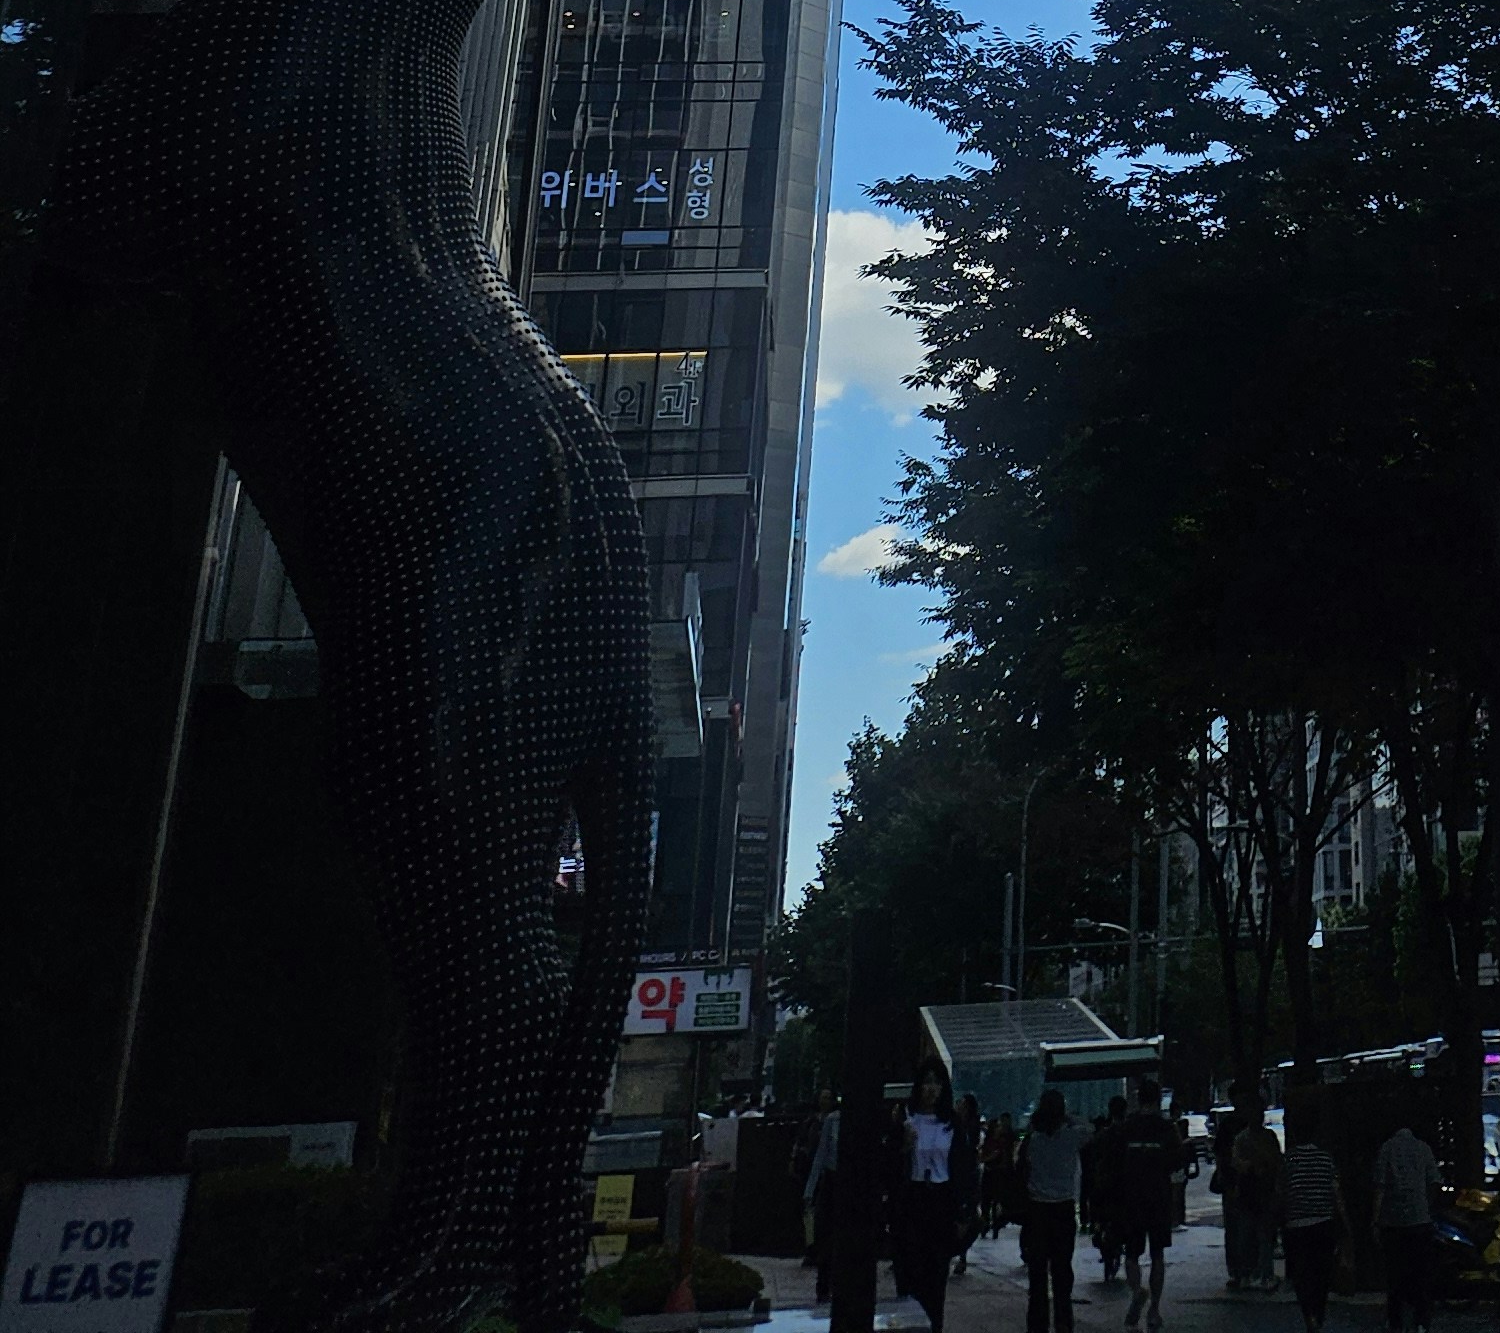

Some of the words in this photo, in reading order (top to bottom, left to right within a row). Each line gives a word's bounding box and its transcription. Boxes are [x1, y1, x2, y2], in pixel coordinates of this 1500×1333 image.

[539, 169, 669, 209] 위버스
[687, 156, 715, 220] 성형
[589, 379, 699, 425] 외과
[637, 976, 686, 1033] 약
[60, 1217, 135, 1252] FOR
[19, 1259, 162, 1304] LEASE
